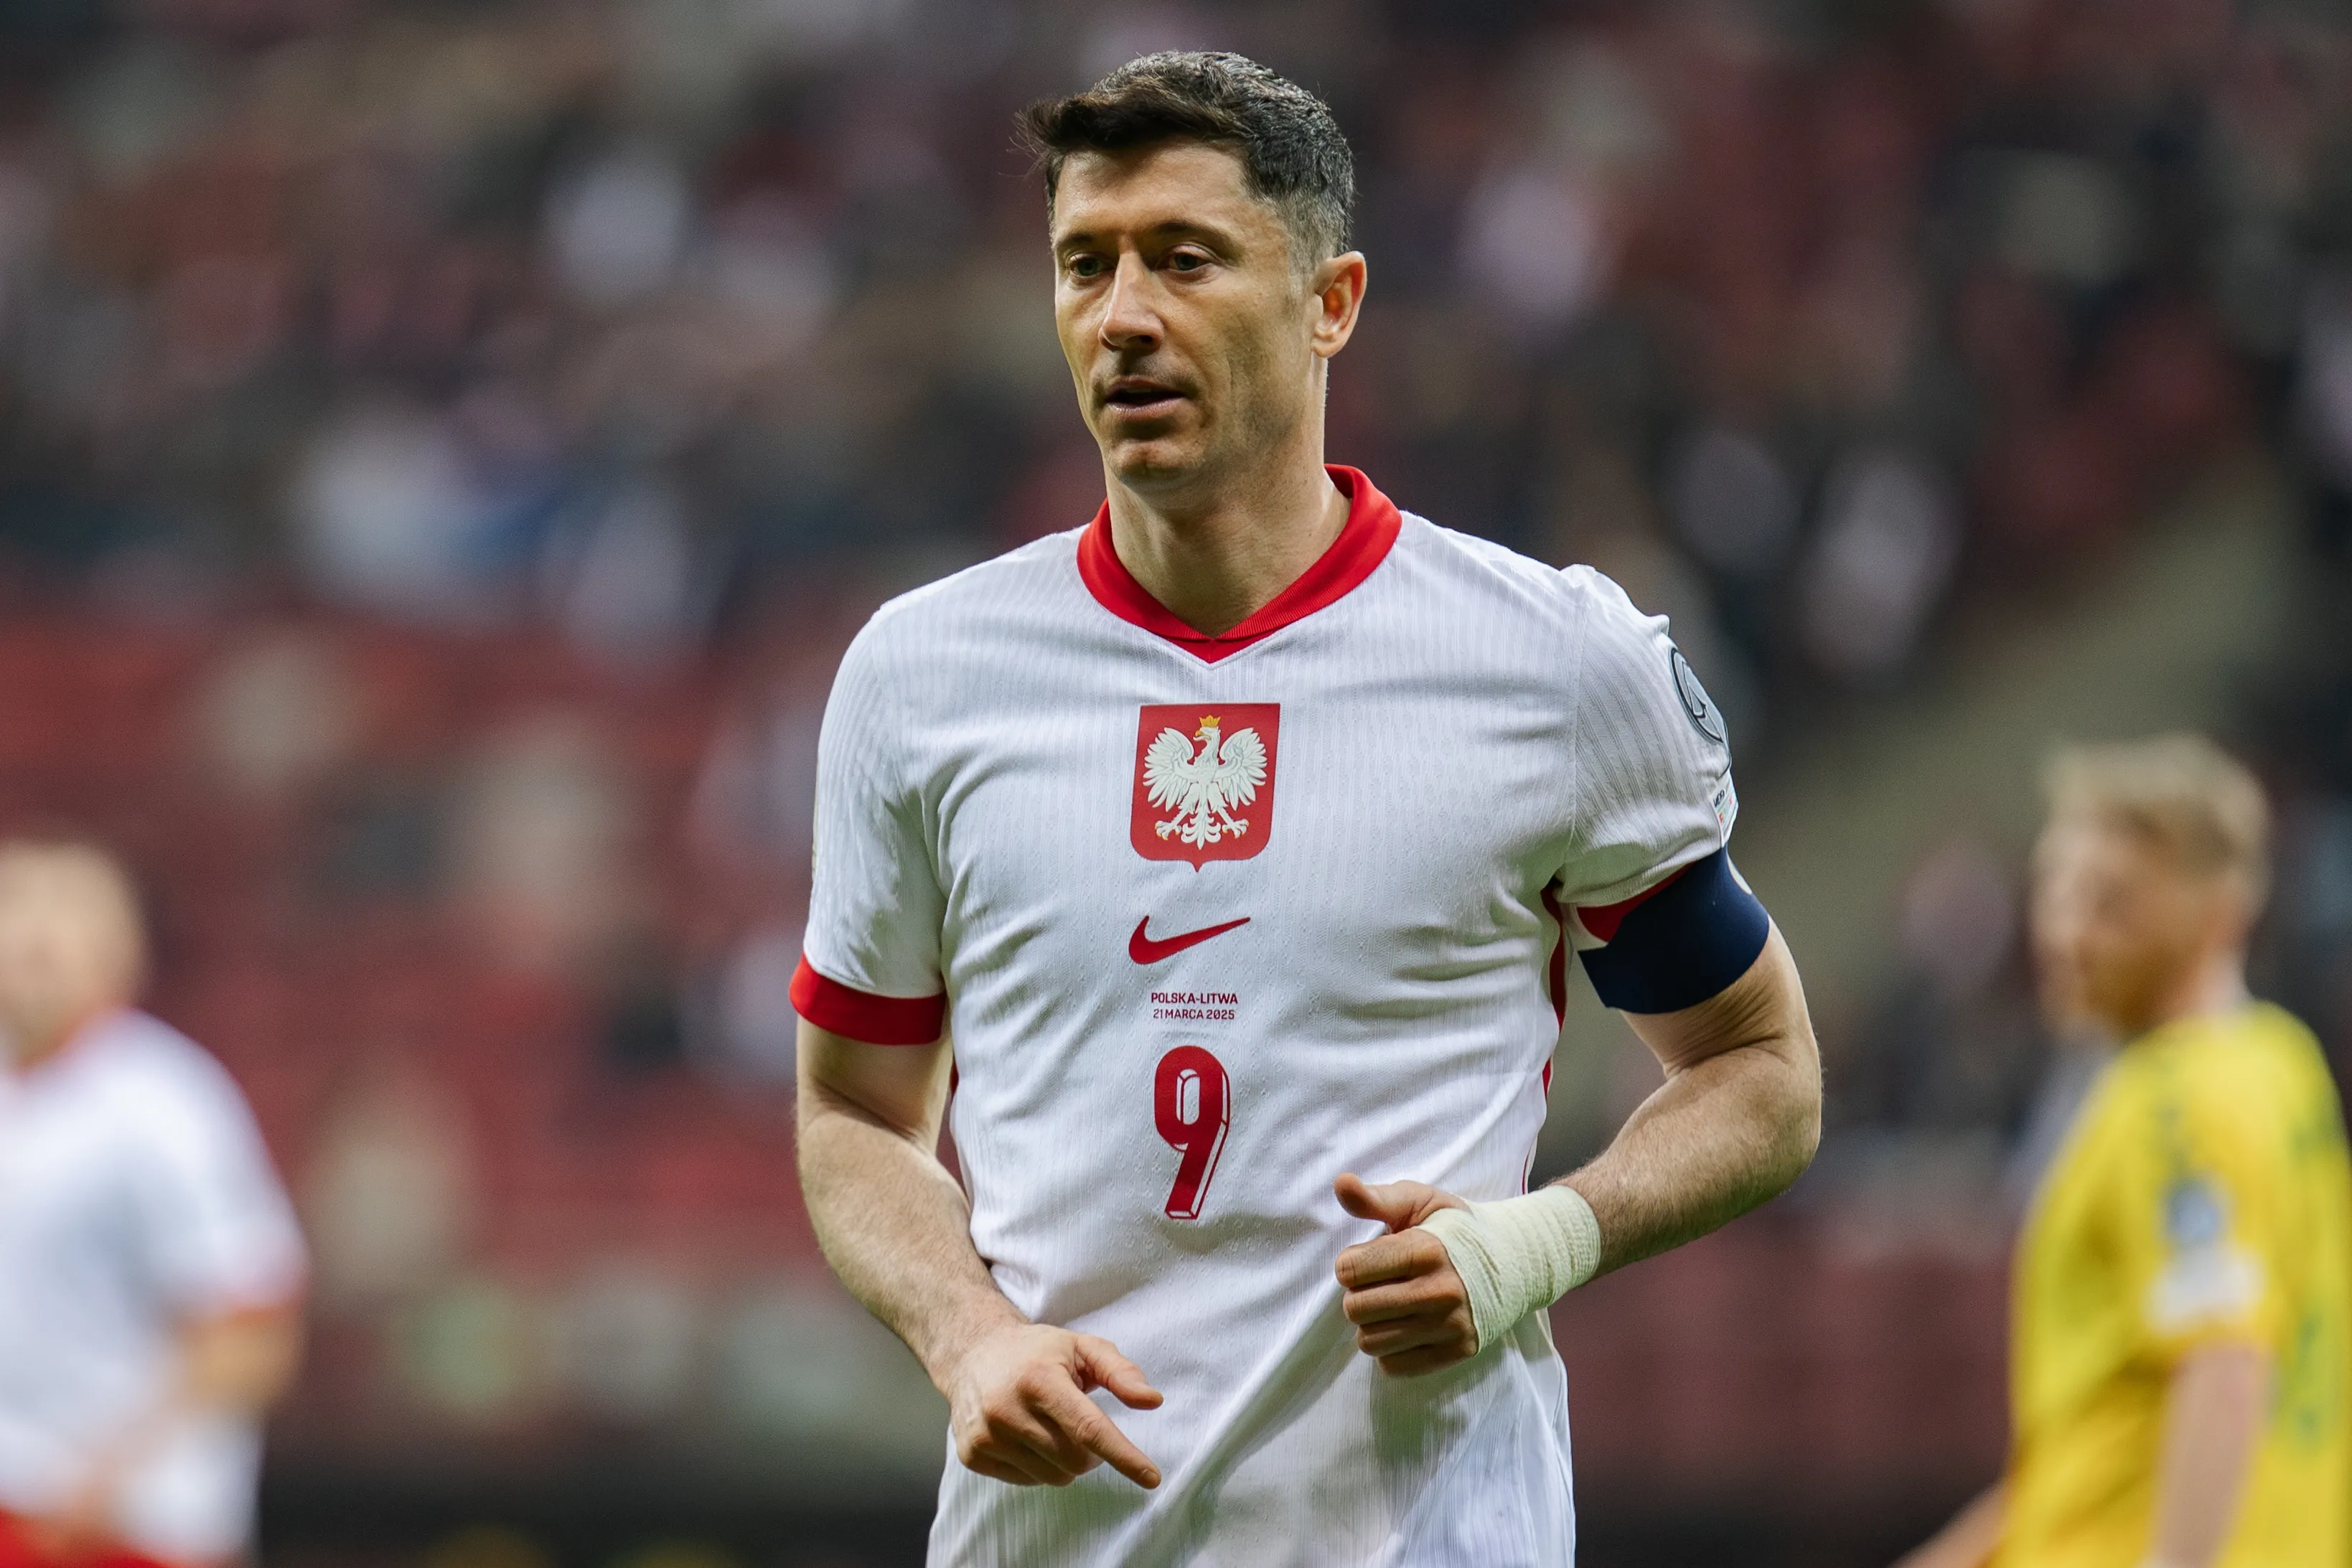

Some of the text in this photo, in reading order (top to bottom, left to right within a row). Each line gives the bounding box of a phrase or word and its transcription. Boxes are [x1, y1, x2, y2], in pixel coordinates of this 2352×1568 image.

[1151, 992, 1238, 1004] POLSKA-LITWA
[1153, 1008, 1235, 1020] 21 MARCA 2025
[1154, 1045, 1231, 1220] 9
